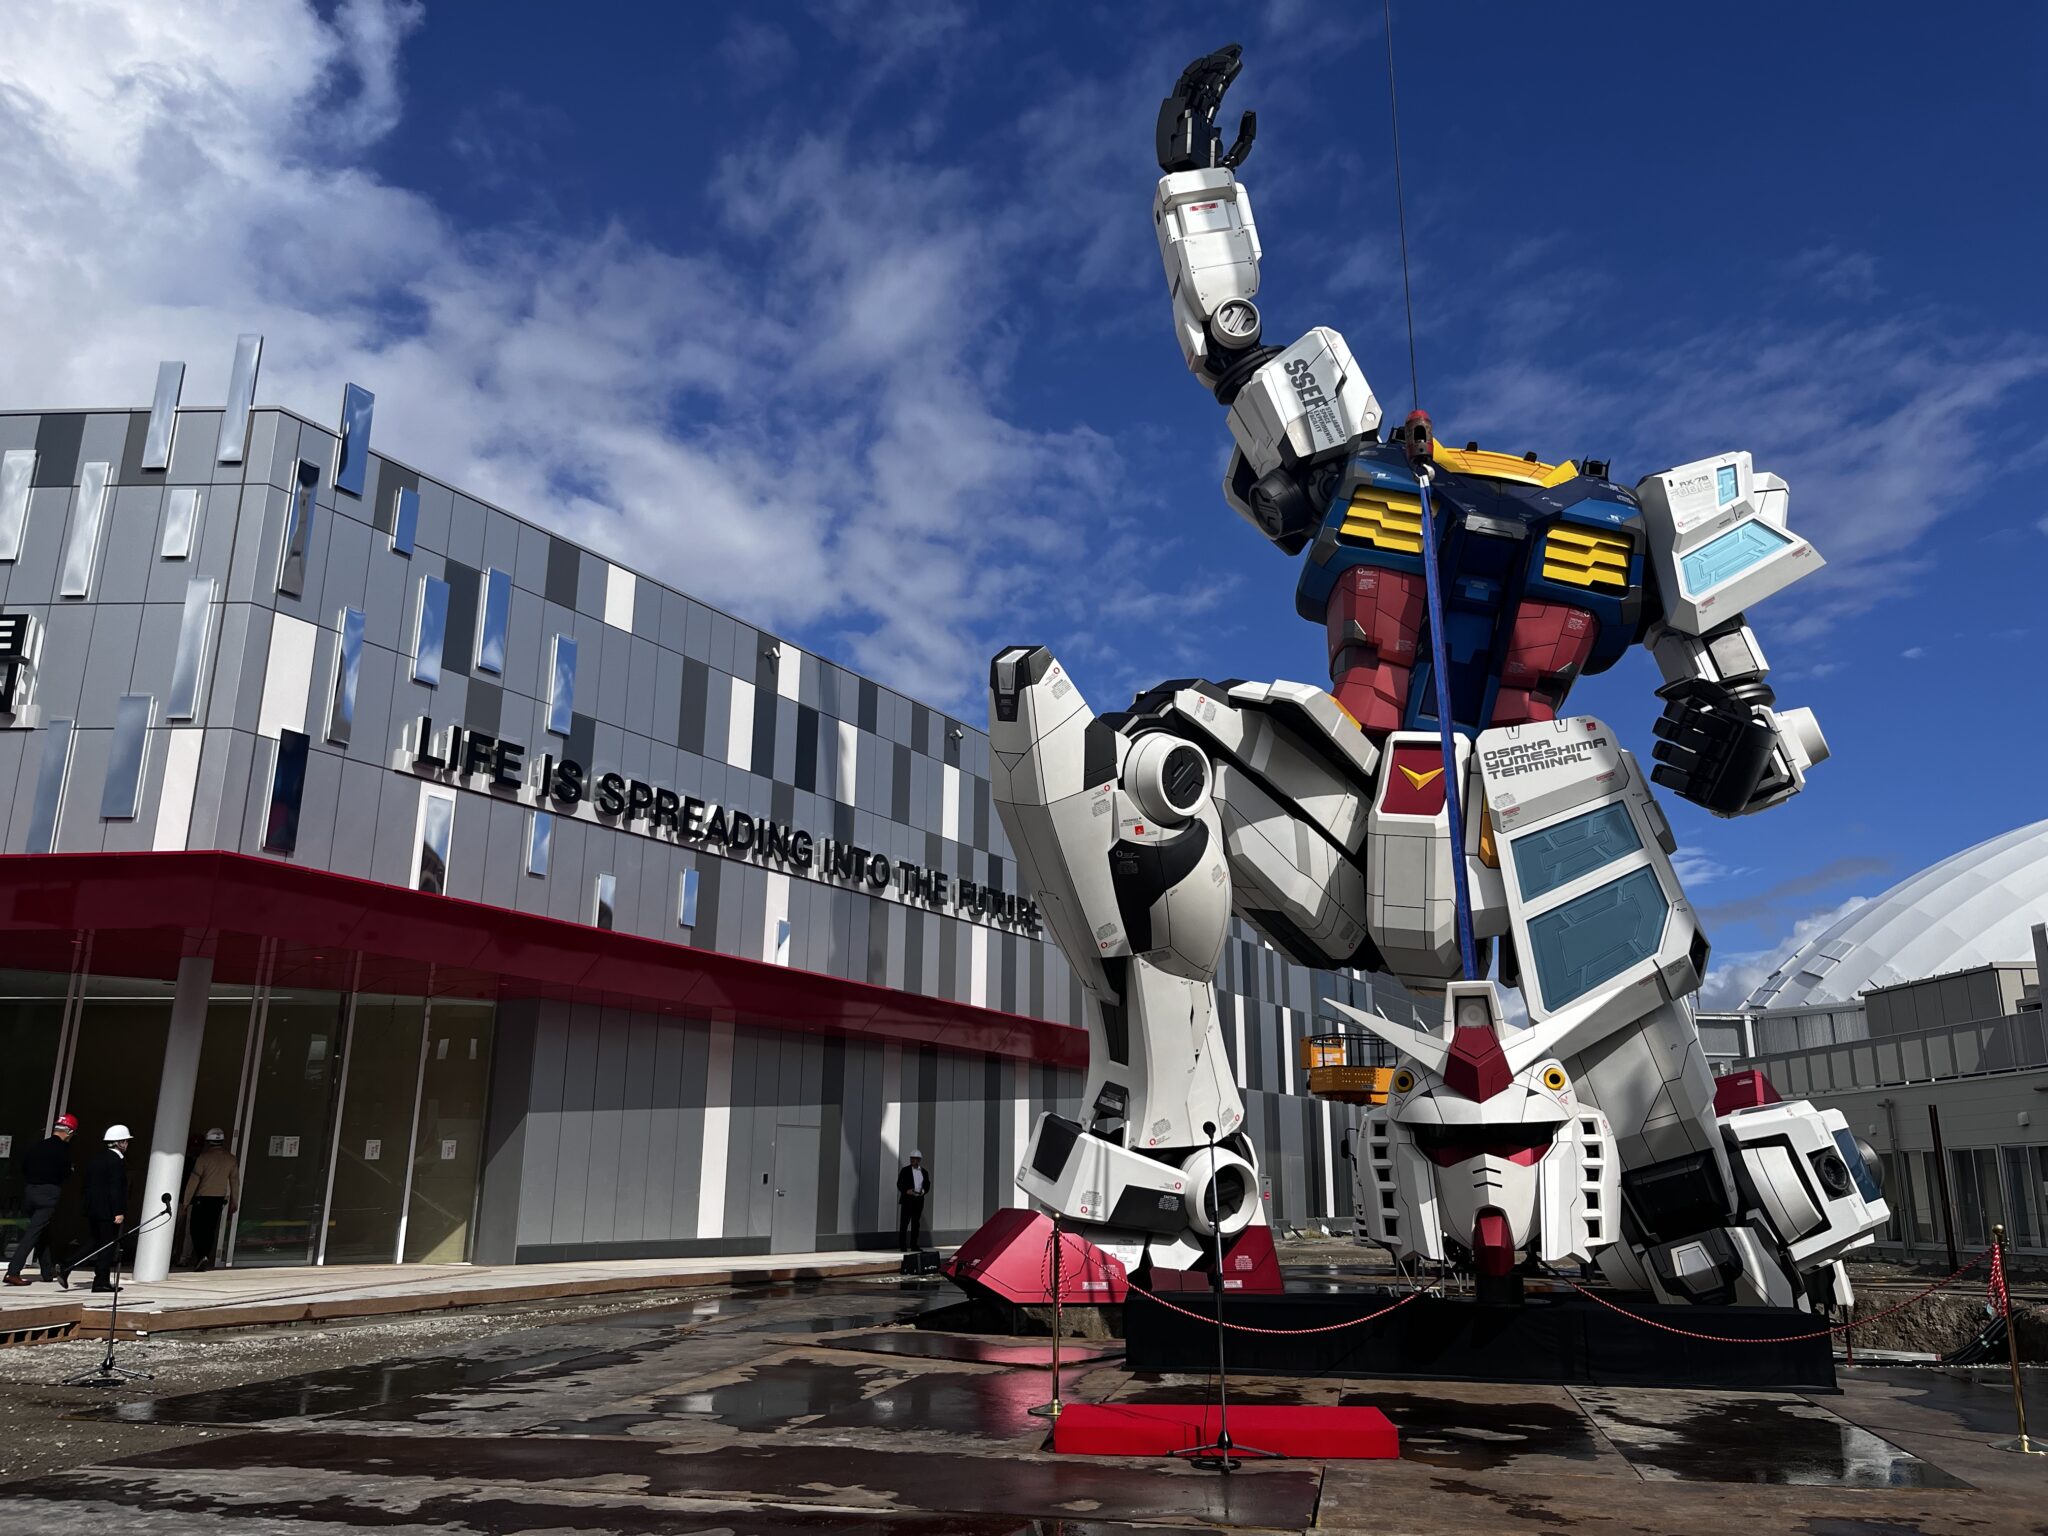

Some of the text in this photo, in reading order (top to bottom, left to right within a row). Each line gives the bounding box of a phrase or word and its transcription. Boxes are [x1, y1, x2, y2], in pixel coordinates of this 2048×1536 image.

[1284, 359, 1328, 408] SSEF
[1484, 739, 1551, 761] OSAKA
[1486, 737, 1608, 771] YUMESHIMA
[1488, 753, 1592, 780] TERMINAL
[414, 716, 1043, 932] LIFE IS SPREADING INTO THE FUTURE
